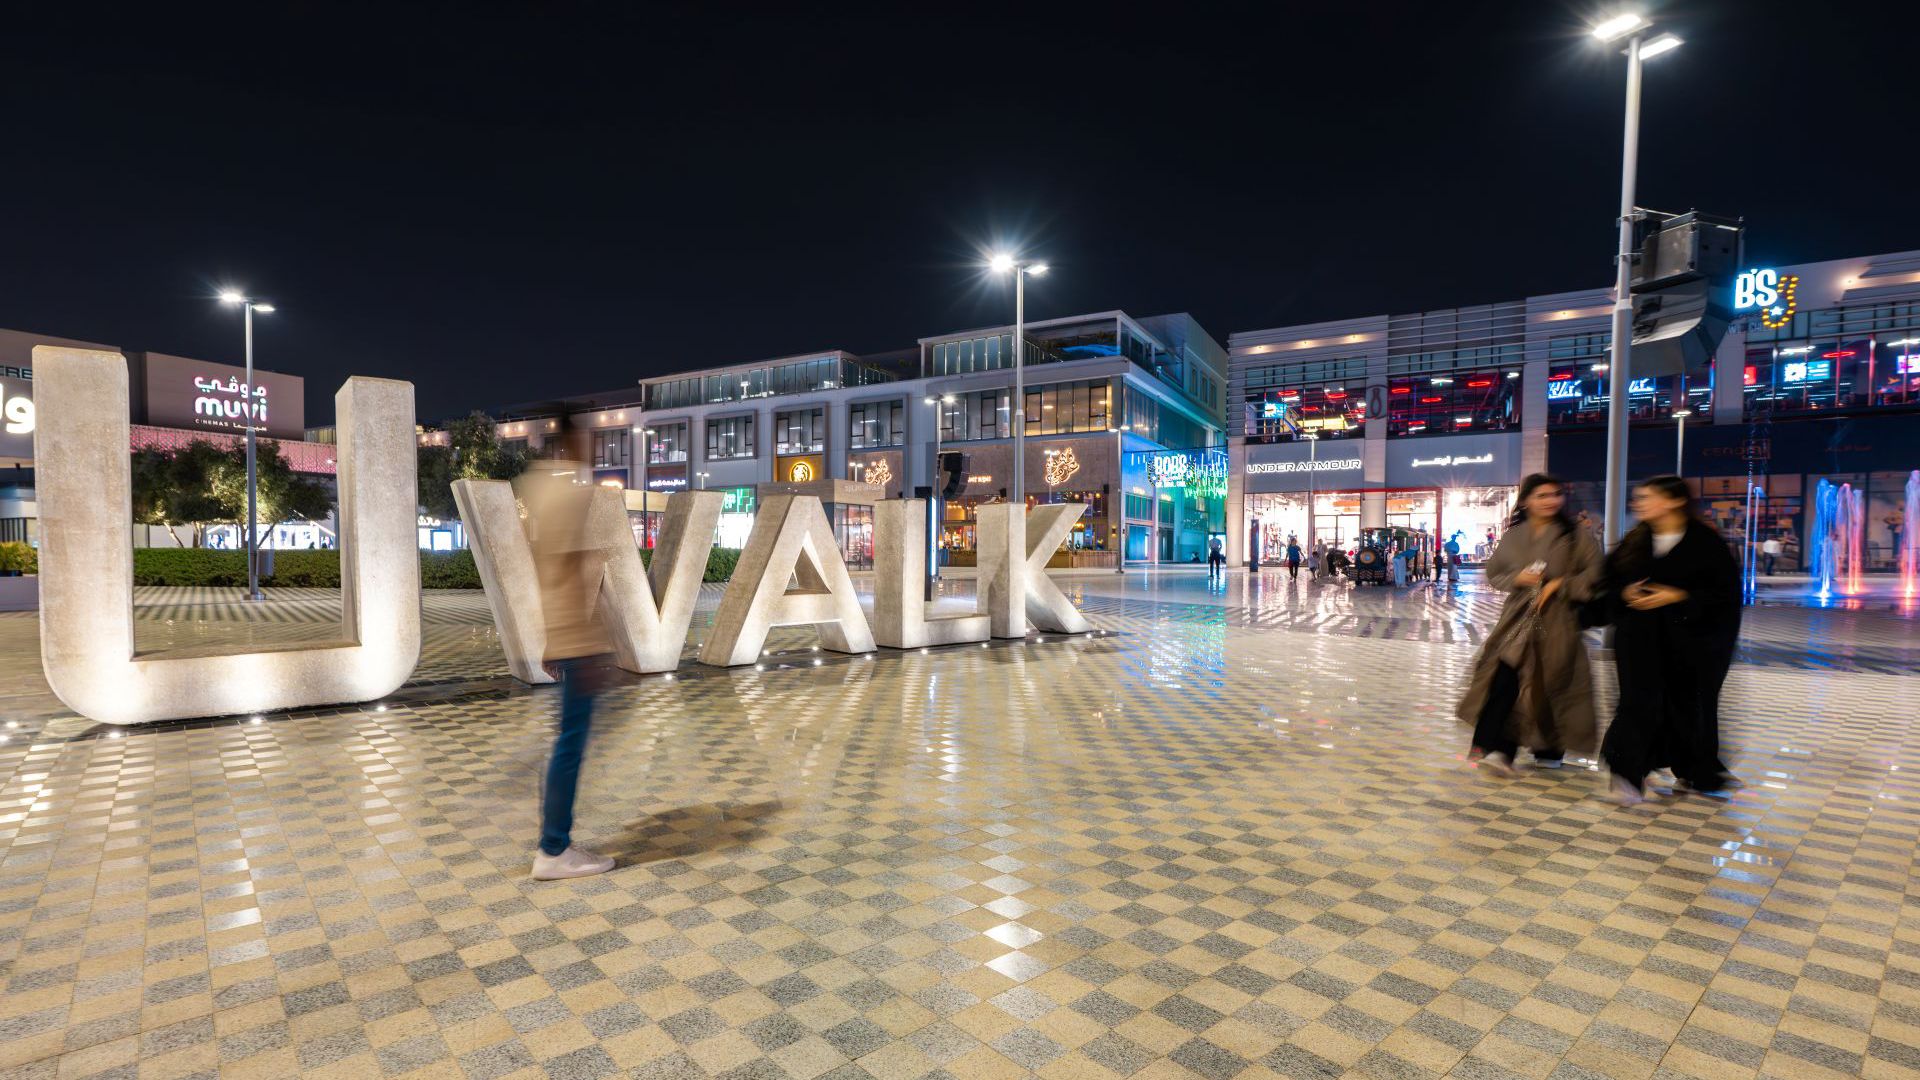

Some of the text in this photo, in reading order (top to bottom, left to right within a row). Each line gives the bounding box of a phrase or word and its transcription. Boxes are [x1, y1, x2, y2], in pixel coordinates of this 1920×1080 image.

[195, 396, 267, 422] muvi
[195, 418, 229, 427] CINEMAS
[1154, 454, 1187, 474] BOB'S
[1246, 459, 1362, 474] UNDER ARMOUR
[31, 345, 1093, 724] U WALK
